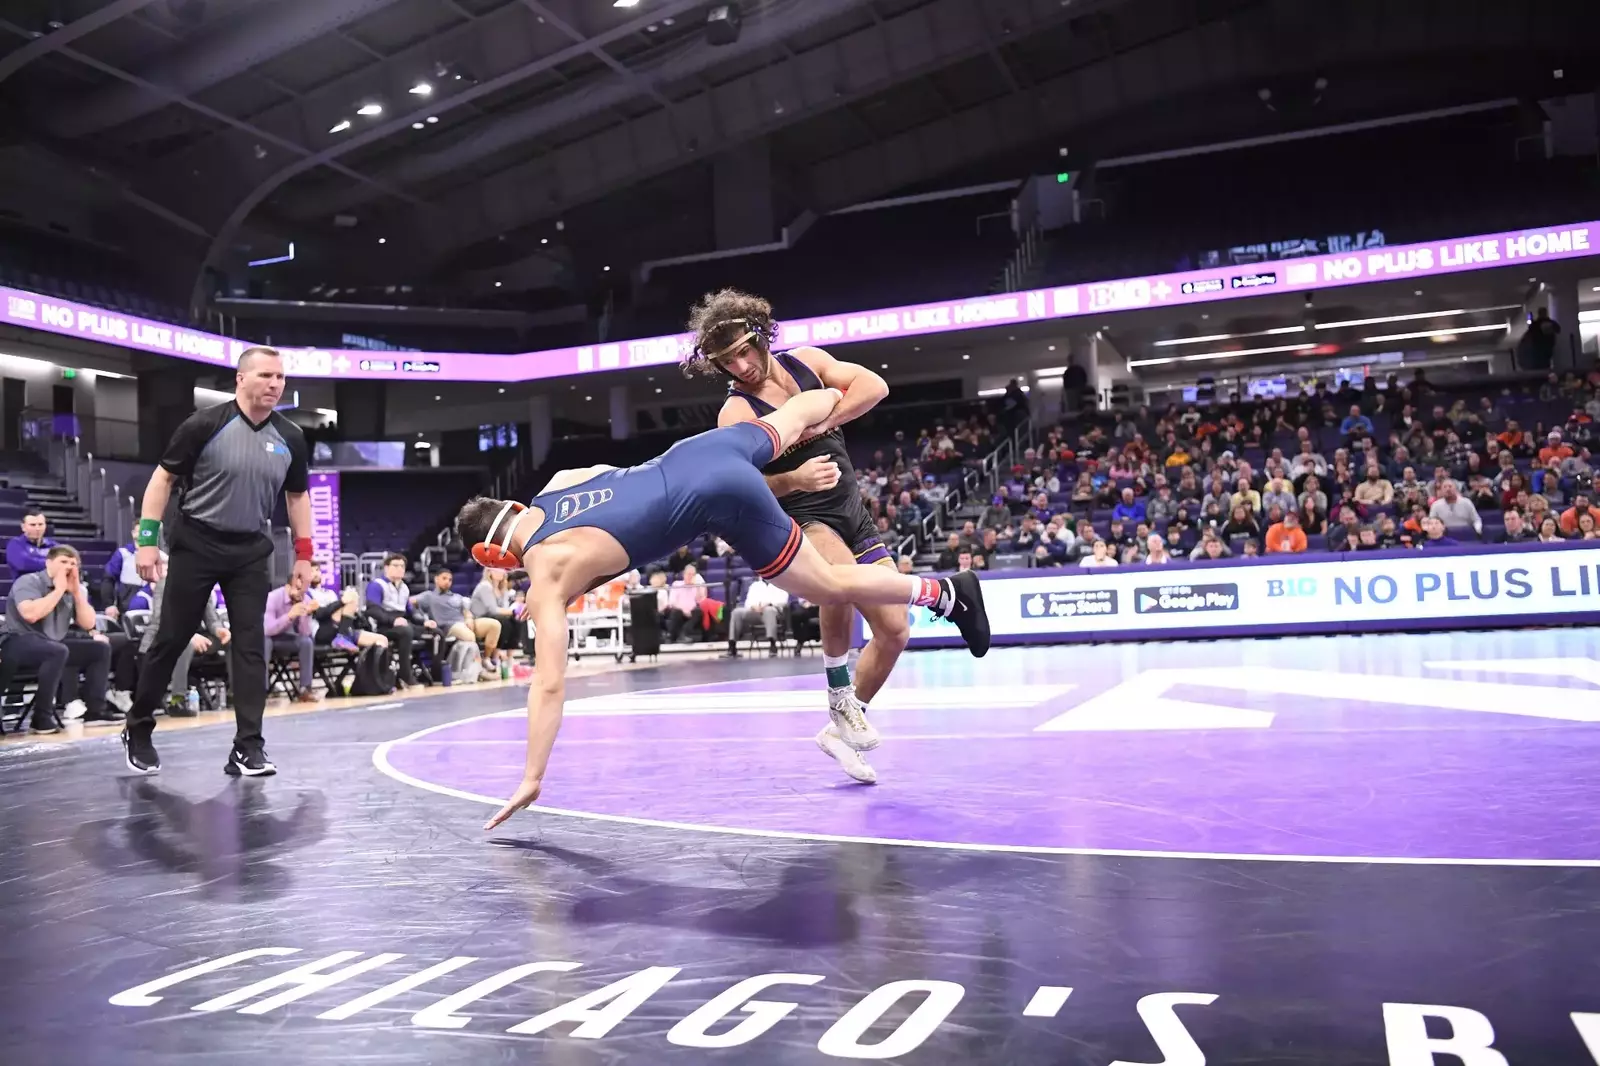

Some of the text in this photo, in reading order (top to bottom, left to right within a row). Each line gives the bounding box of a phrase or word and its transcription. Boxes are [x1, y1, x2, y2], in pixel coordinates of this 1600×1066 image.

[1323, 257, 1362, 281] NO
[1368, 248, 1434, 277] PLUS
[1440, 239, 1500, 267] LIKE
[1506, 228, 1590, 260] HOME
[42, 303, 74, 329] NO
[78, 311, 128, 340] PLUS
[132, 323, 172, 349] LIKE
[175, 332, 225, 361] HOME
[812, 319, 843, 340] NO
[847, 313, 899, 336] PLUS
[902, 307, 951, 330] LIKE
[954, 298, 1019, 324] HOME
[1159, 592, 1235, 610] Google Play
[1334, 575, 1398, 605] NO
[1415, 568, 1533, 602] PLUS
[1049, 600, 1112, 616] App Store
[108, 947, 1219, 1066] CHICAGO'S
